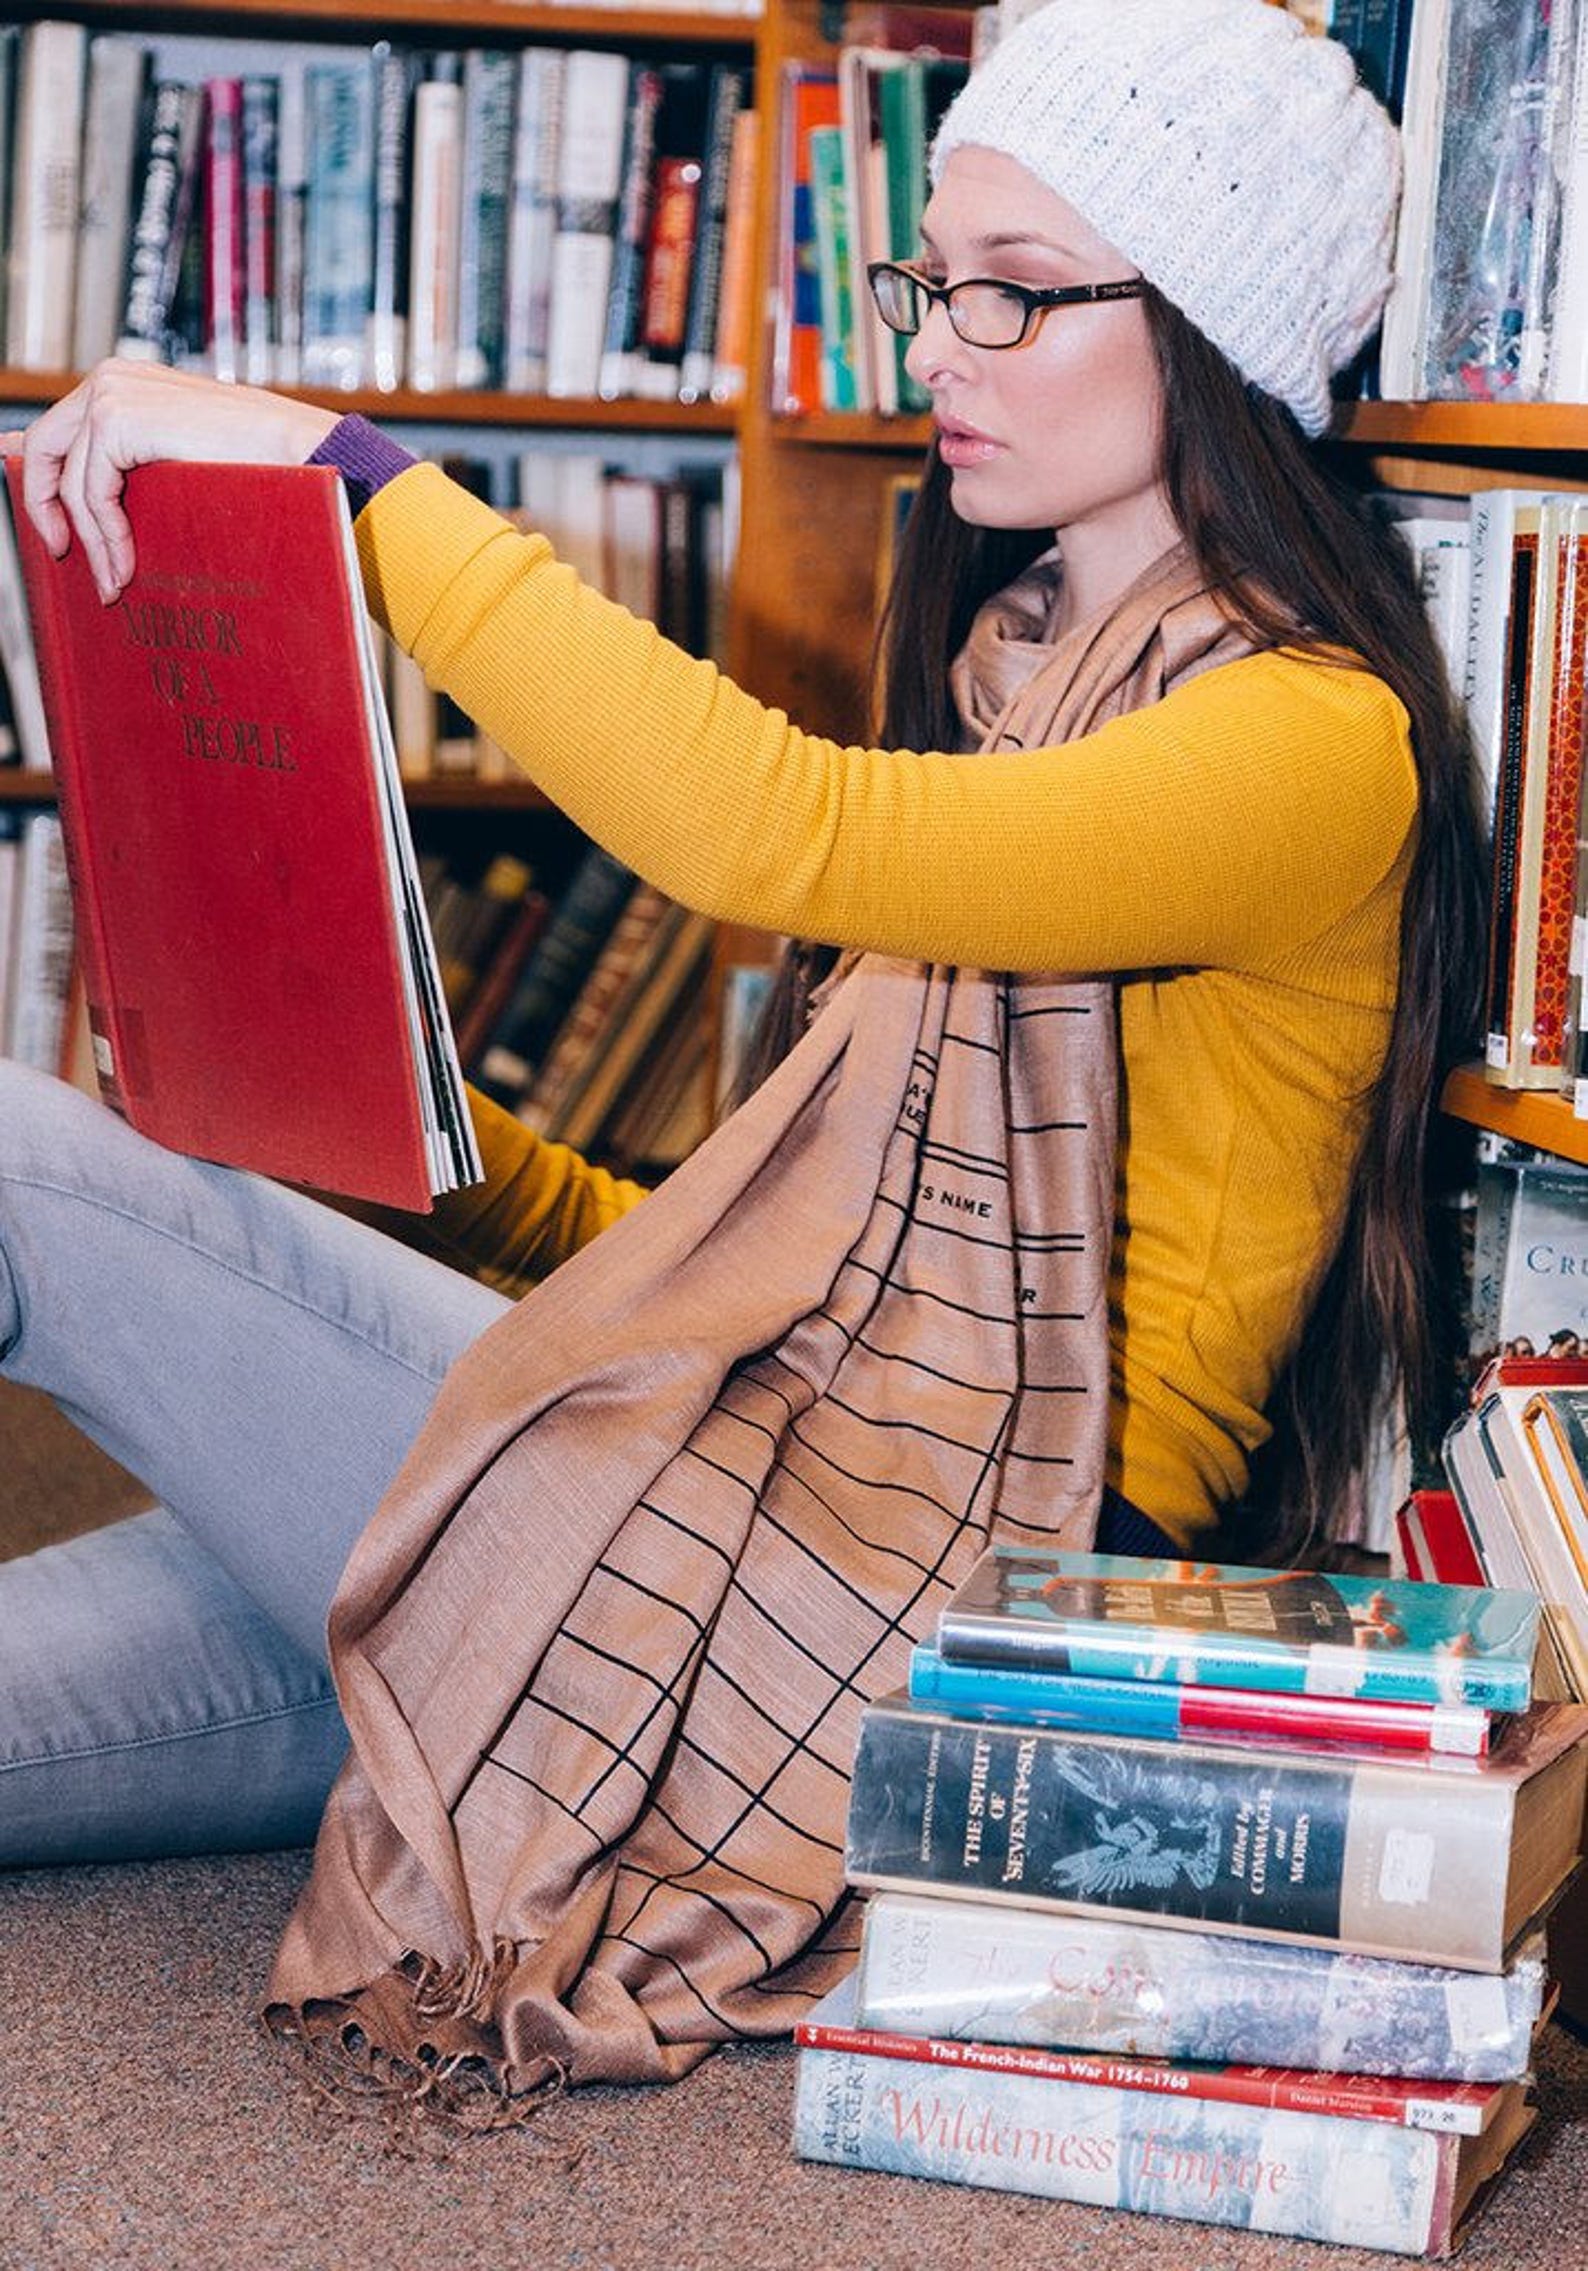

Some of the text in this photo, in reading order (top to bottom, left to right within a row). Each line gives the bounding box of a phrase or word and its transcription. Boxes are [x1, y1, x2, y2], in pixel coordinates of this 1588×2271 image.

[121, 601, 243, 656] MIRROR
[151, 655, 221, 705] OF A
[182, 711, 298, 772] PEOPLE
[920, 1778, 937, 1862] BICENTENNIAL
[963, 1738, 992, 1868] THE SPIRIT
[989, 1791, 1006, 1820] OF
[1002, 1736, 1038, 1882] SEVENTY-SIX
[1230, 1799, 1256, 1880] Edited by
[1250, 1787, 1275, 1896] COMMAGER
[1273, 1826, 1288, 1860] and
[1290, 1812, 1311, 1884] MORRIS
[904, 1919, 933, 2018] EKERT
[929, 2042, 959, 2060] The
[962, 2044, 1067, 2074] French-Indian
[1069, 2061, 1103, 2079] War
[822, 2082, 840, 2151] ALLAN
[841, 2055, 867, 2156] ECKERT
[880, 2087, 1292, 2198] Wilderness Empire
